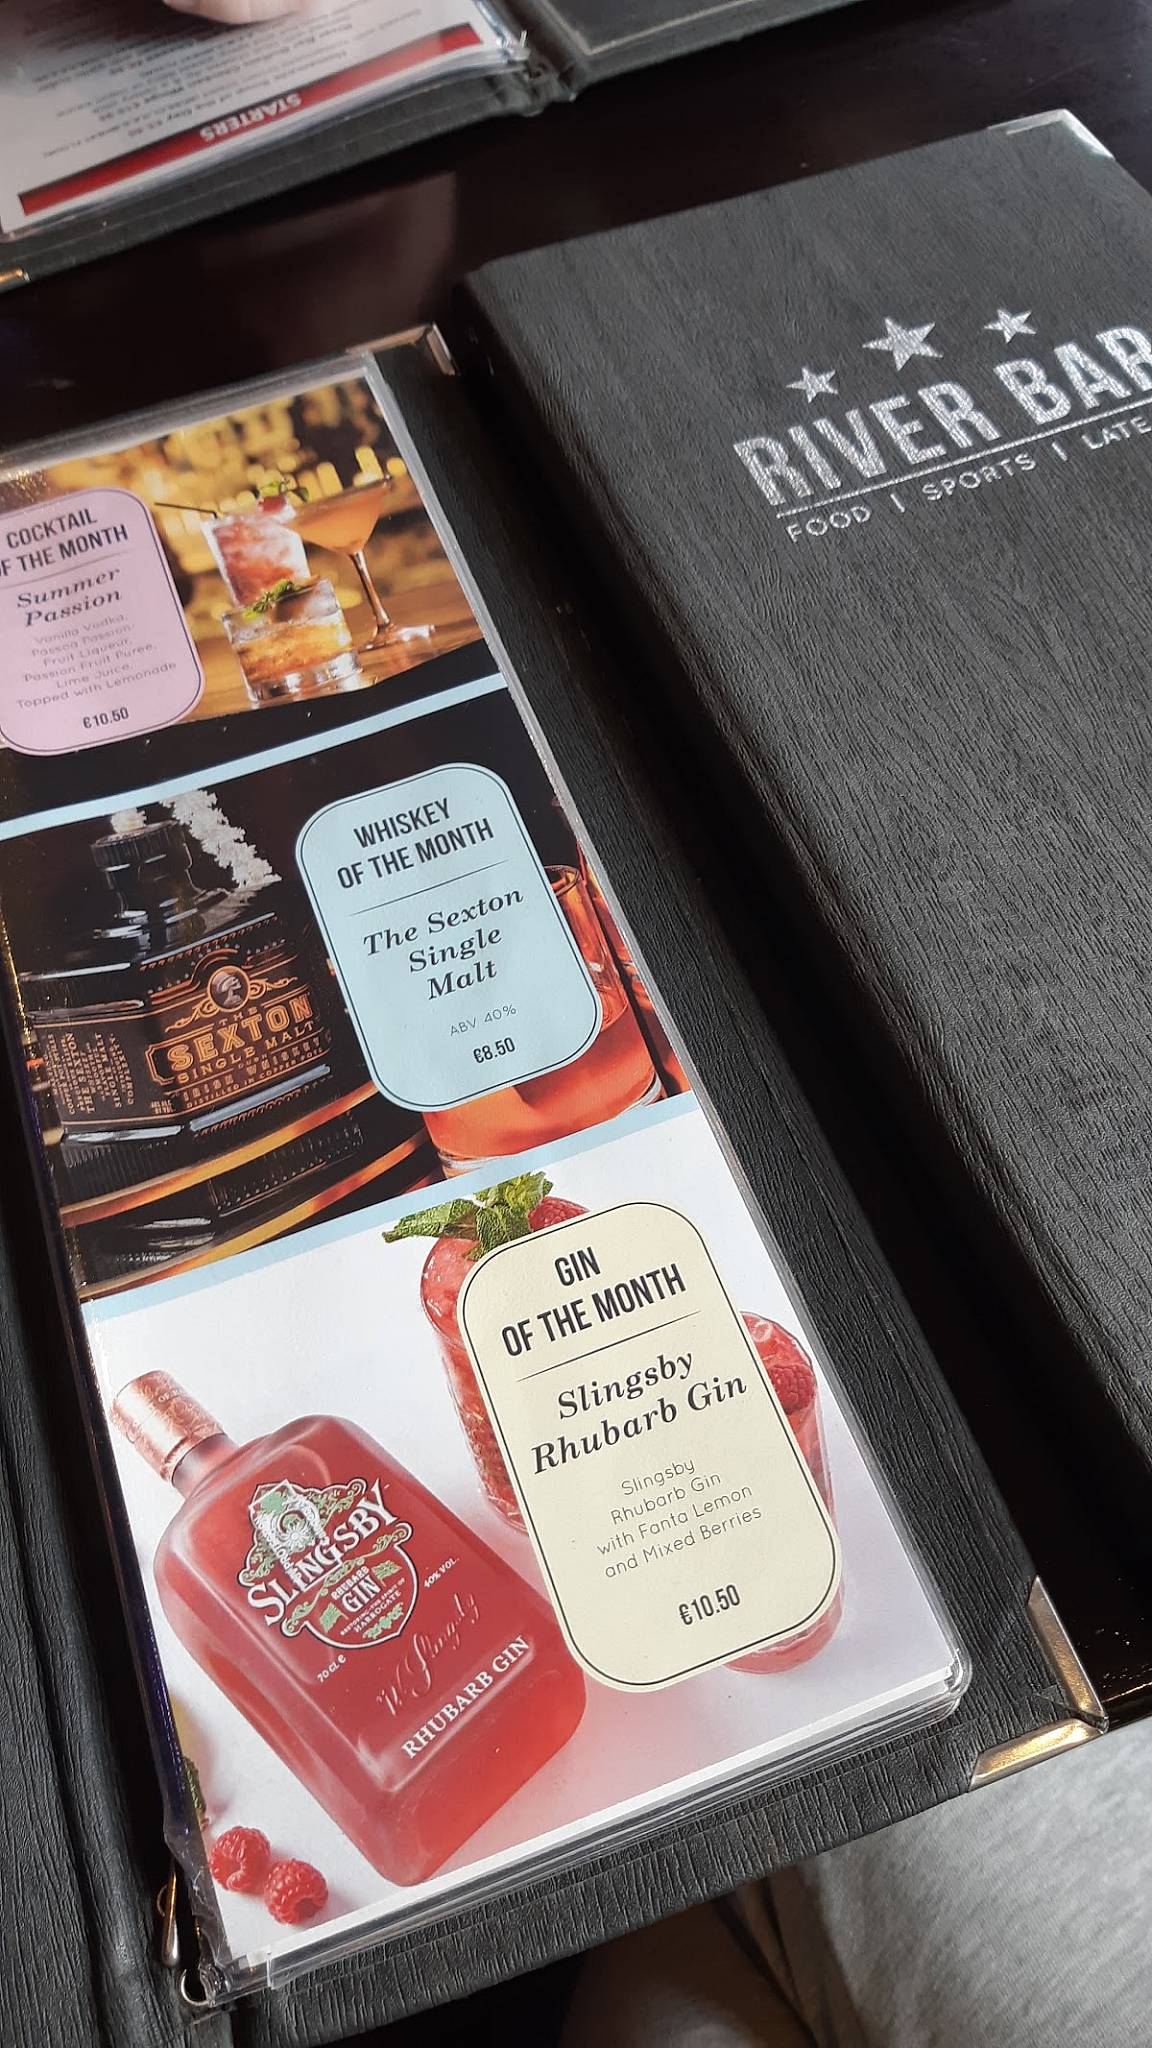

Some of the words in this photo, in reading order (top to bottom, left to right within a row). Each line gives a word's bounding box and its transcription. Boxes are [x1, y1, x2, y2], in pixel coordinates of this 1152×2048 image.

[201, 94, 302, 142] STARTERS
[733, 381, 1001, 506] RIVER
[993, 324, 1152, 426] BAR
[786, 504, 872, 543] FOOD
[922, 452, 1037, 502] SPORTS
[1081, 415, 1152, 450] LATE
[6, 508, 97, 548] COCKTAIL
[16, 547, 56, 572] THE
[58, 524, 128, 560] MONTH
[18, 569, 120, 608] Summer
[26, 591, 122, 627] Passion
[33, 628, 79, 644] Vanilla
[24, 667, 76, 682] Passion
[80, 657, 111, 670] Fruit
[43, 654, 74, 666] Fruit
[56, 675, 90, 689] Lime
[17, 690, 69, 709] Topped
[73, 684, 102, 698] with
[106, 662, 177, 690] Lemonade
[82, 706, 130, 729] €10.50
[353, 798, 452, 848] WHISKEY
[337, 862, 364, 890] OF
[368, 848, 414, 880] THE
[416, 818, 494, 864] MONTH
[363, 920, 418, 956] The
[426, 890, 524, 934] Sexton
[408, 926, 503, 973] Single
[428, 960, 498, 1000] Malt
[167, 994, 314, 1072] SEXTON
[219, 1006, 258, 1026] THE
[450, 1017, 477, 1036] ABV
[484, 1004, 518, 1024] 40%
[177, 1046, 256, 1084] SINGLE
[264, 1020, 315, 1050] MALT
[472, 1037, 516, 1064] €8.50
[554, 1246, 602, 1287] GIN
[501, 1318, 534, 1358] OF
[536, 1302, 593, 1344] THE
[595, 1262, 687, 1324] MONTH
[558, 1352, 694, 1421] Slingsby
[531, 1394, 678, 1476] Rhubarb
[687, 1374, 748, 1412] Gin
[610, 1487, 686, 1525] Rhubarb
[690, 1474, 721, 1492] Gin
[621, 1460, 695, 1496] Slingsby
[596, 1532, 634, 1555] with
[638, 1512, 688, 1539] Fanta
[692, 1486, 752, 1518] Lemon
[605, 1554, 638, 1578] and
[642, 1530, 696, 1563] Mixed
[699, 1506, 762, 1540] Berries
[247, 1478, 400, 1626] SLINGSBY
[331, 1566, 370, 1600] RHUBARB
[342, 1575, 381, 1612] GIN
[424, 1572, 441, 1588] 40%
[354, 1590, 400, 1632] HARROGATE
[679, 1584, 740, 1625] €10.50
[401, 1668, 494, 1759] RHUBARB
[492, 1634, 530, 1674] GIN
